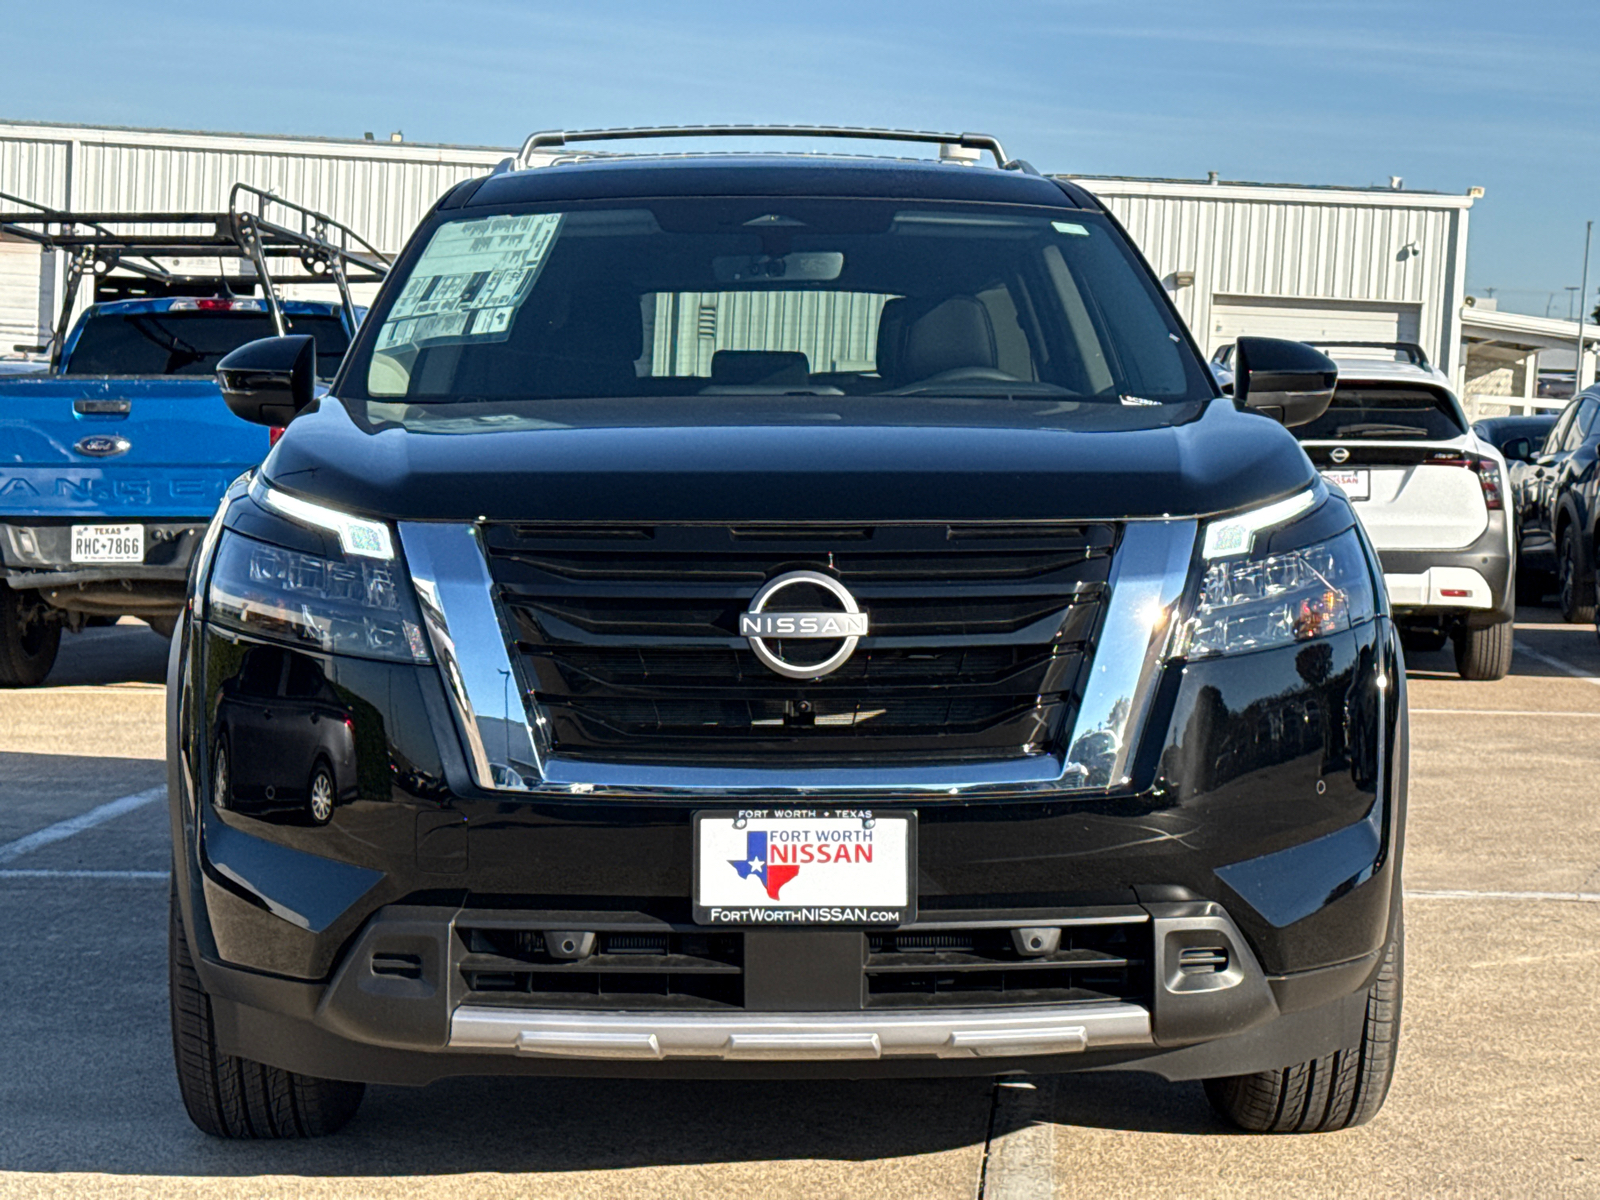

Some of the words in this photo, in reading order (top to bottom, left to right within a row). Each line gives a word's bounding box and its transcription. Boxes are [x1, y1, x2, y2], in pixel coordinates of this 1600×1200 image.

[86, 440, 111, 450] Ford
[94, 527, 121, 535] TEXAS
[743, 617, 864, 633] NISSAN
[738, 809, 768, 818] FORT
[774, 809, 816, 818] WORTH
[835, 809, 872, 818] TEXAS
[770, 830, 811, 842] FORT
[815, 830, 873, 842] WORTH
[770, 843, 873, 864] NISSAN
